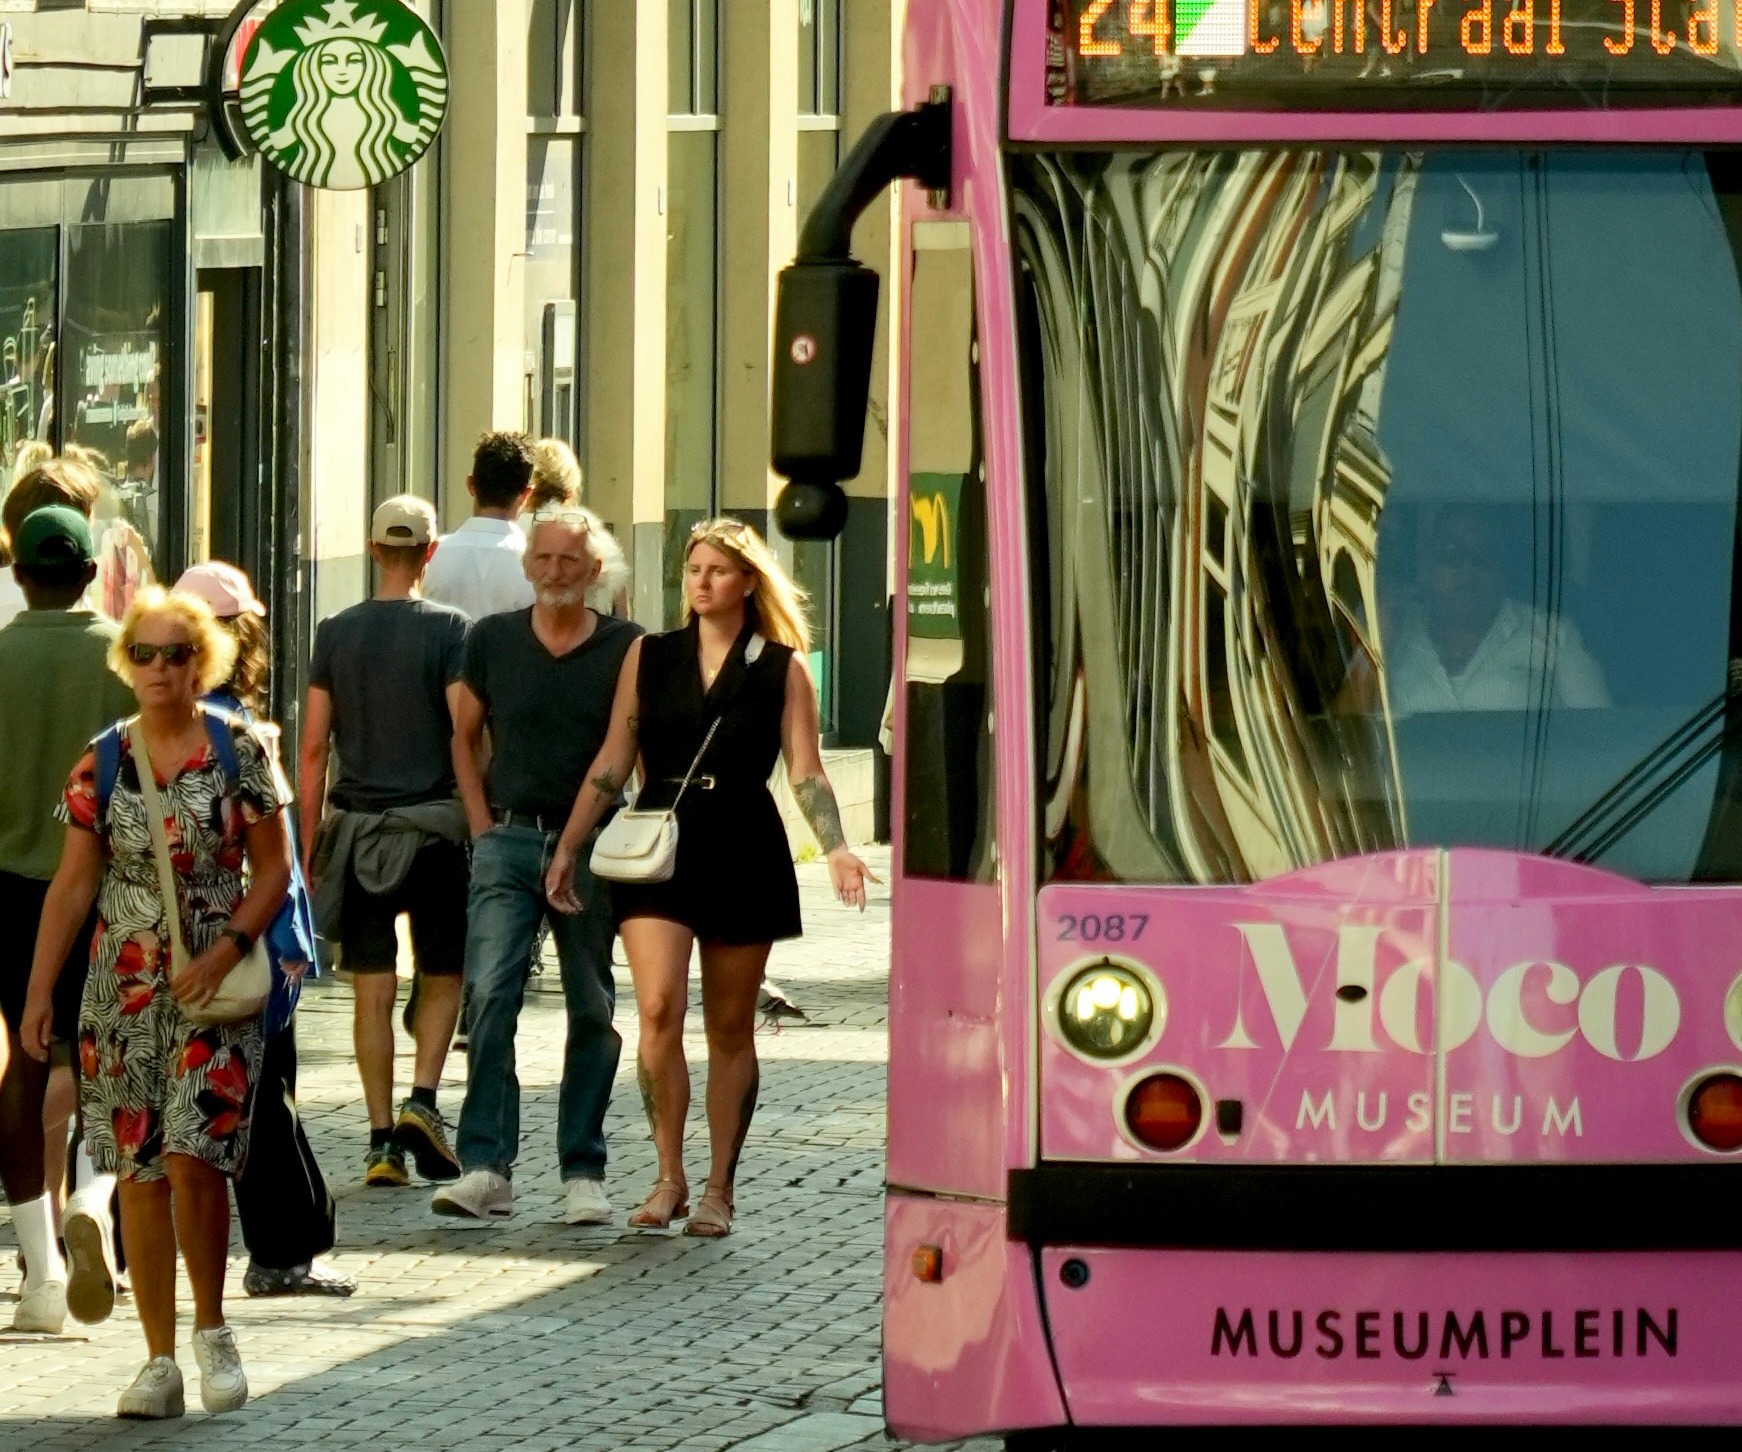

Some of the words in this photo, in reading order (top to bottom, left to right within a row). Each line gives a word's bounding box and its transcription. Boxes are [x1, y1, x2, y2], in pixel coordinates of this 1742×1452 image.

[1056, 914, 1151, 942] 2087
[1215, 923, 1681, 1062] Moco
[1295, 1088, 1584, 1137] MUSEUM
[1210, 1307, 1678, 1360] MUSEUMPLEIN
